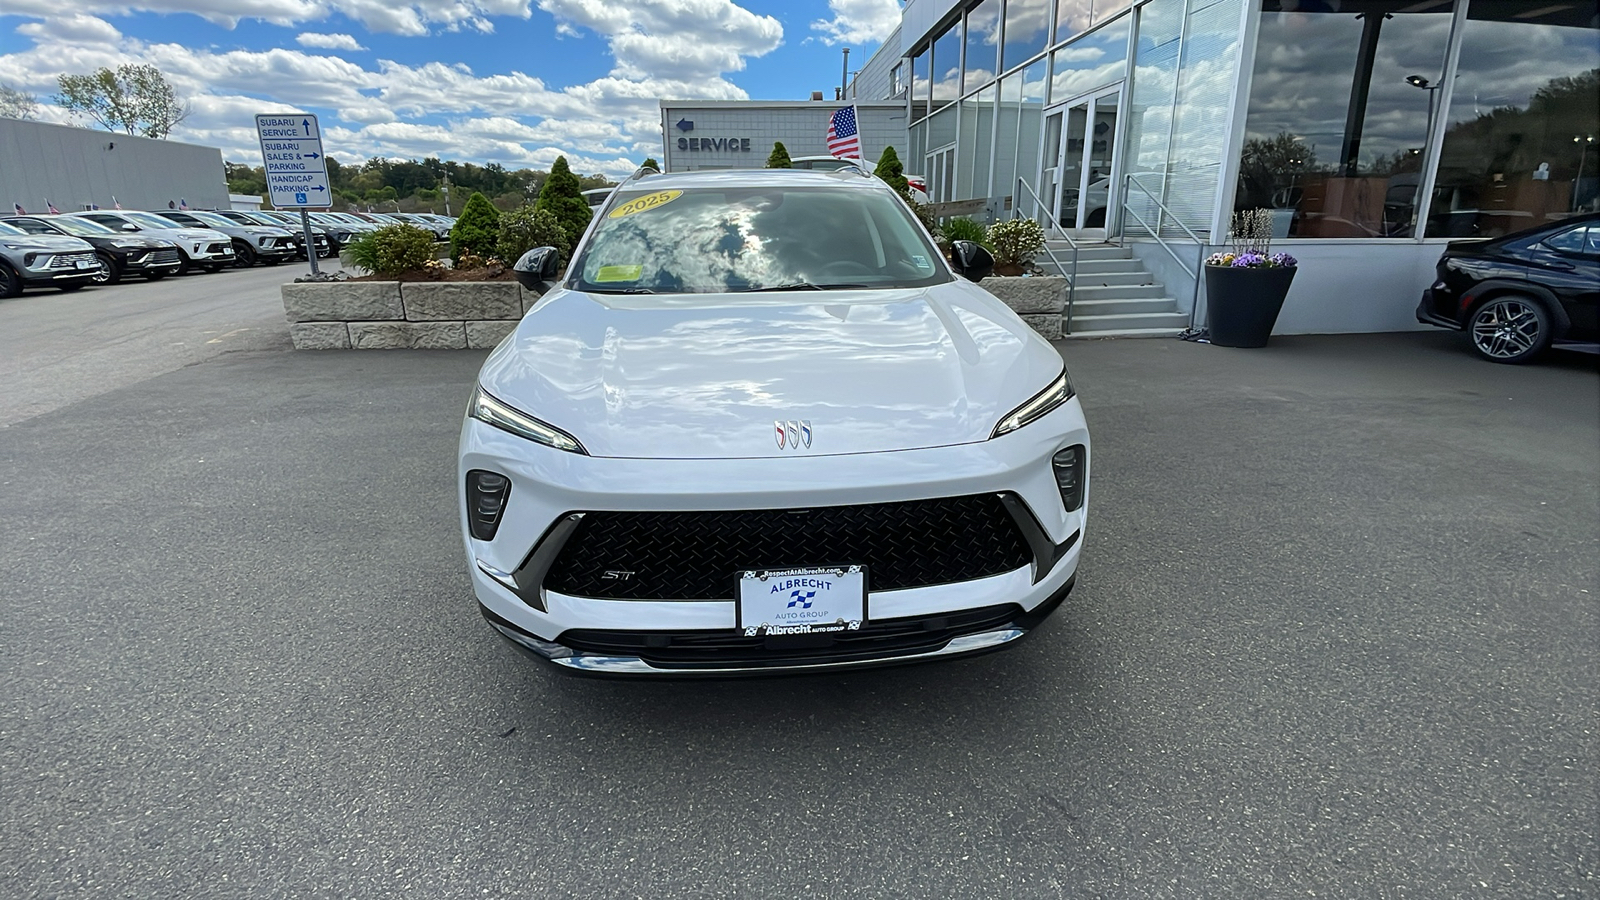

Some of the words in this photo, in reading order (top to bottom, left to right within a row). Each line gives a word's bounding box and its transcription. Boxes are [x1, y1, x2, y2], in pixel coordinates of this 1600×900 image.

[677, 137, 751, 152] SERVICE
[622, 192, 671, 215] 2025
[601, 570, 635, 580] ST
[764, 567, 841, 577] RespectAtAlbrecht.com
[770, 578, 832, 594] ALBRECHT
[799, 610, 829, 618] GROUP
[765, 624, 812, 635] Albrecht
